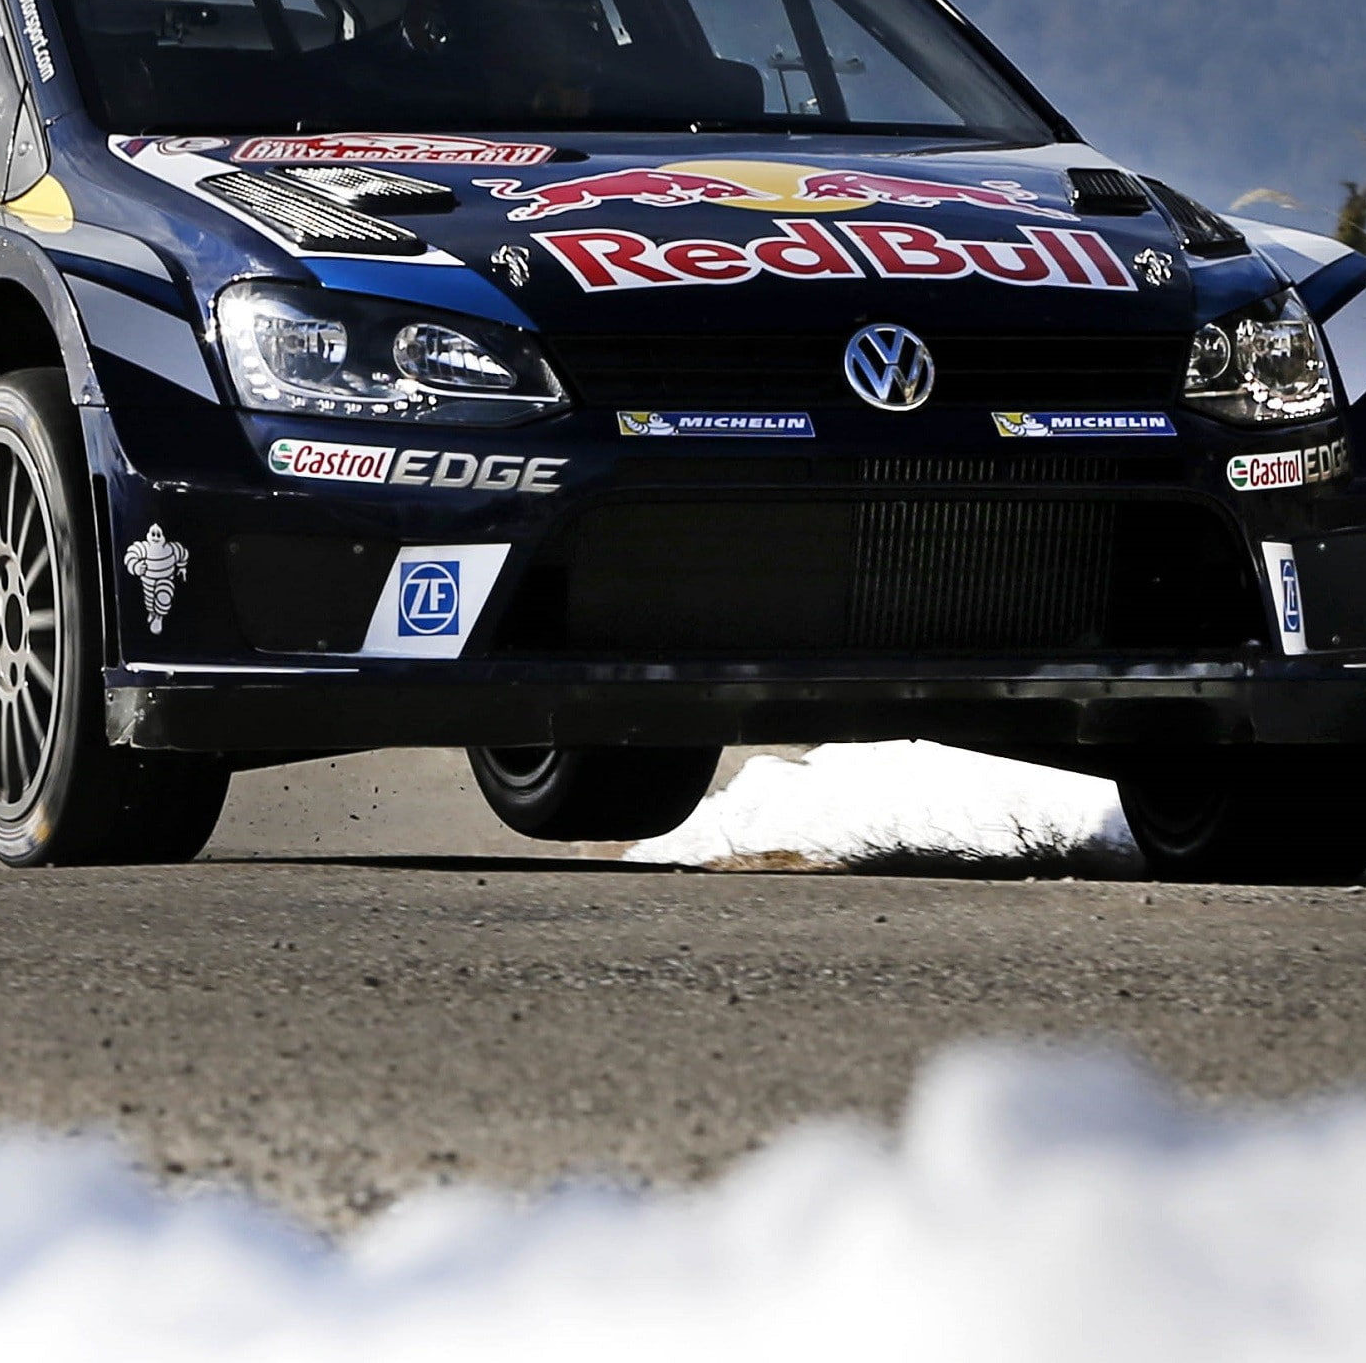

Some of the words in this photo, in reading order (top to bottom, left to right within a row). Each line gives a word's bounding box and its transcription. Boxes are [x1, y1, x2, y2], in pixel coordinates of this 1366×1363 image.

[247, 140, 338, 159] RALLYE
[533, 219, 866, 292] Red
[835, 221, 1137, 291] Bull
[678, 417, 806, 429] MICHELIN
[1050, 417, 1166, 428] MICHELIN
[293, 445, 387, 479] Castrol
[389, 449, 570, 494] EDGE
[1250, 454, 1301, 487] Castrol
[403, 576, 455, 620] ZF
